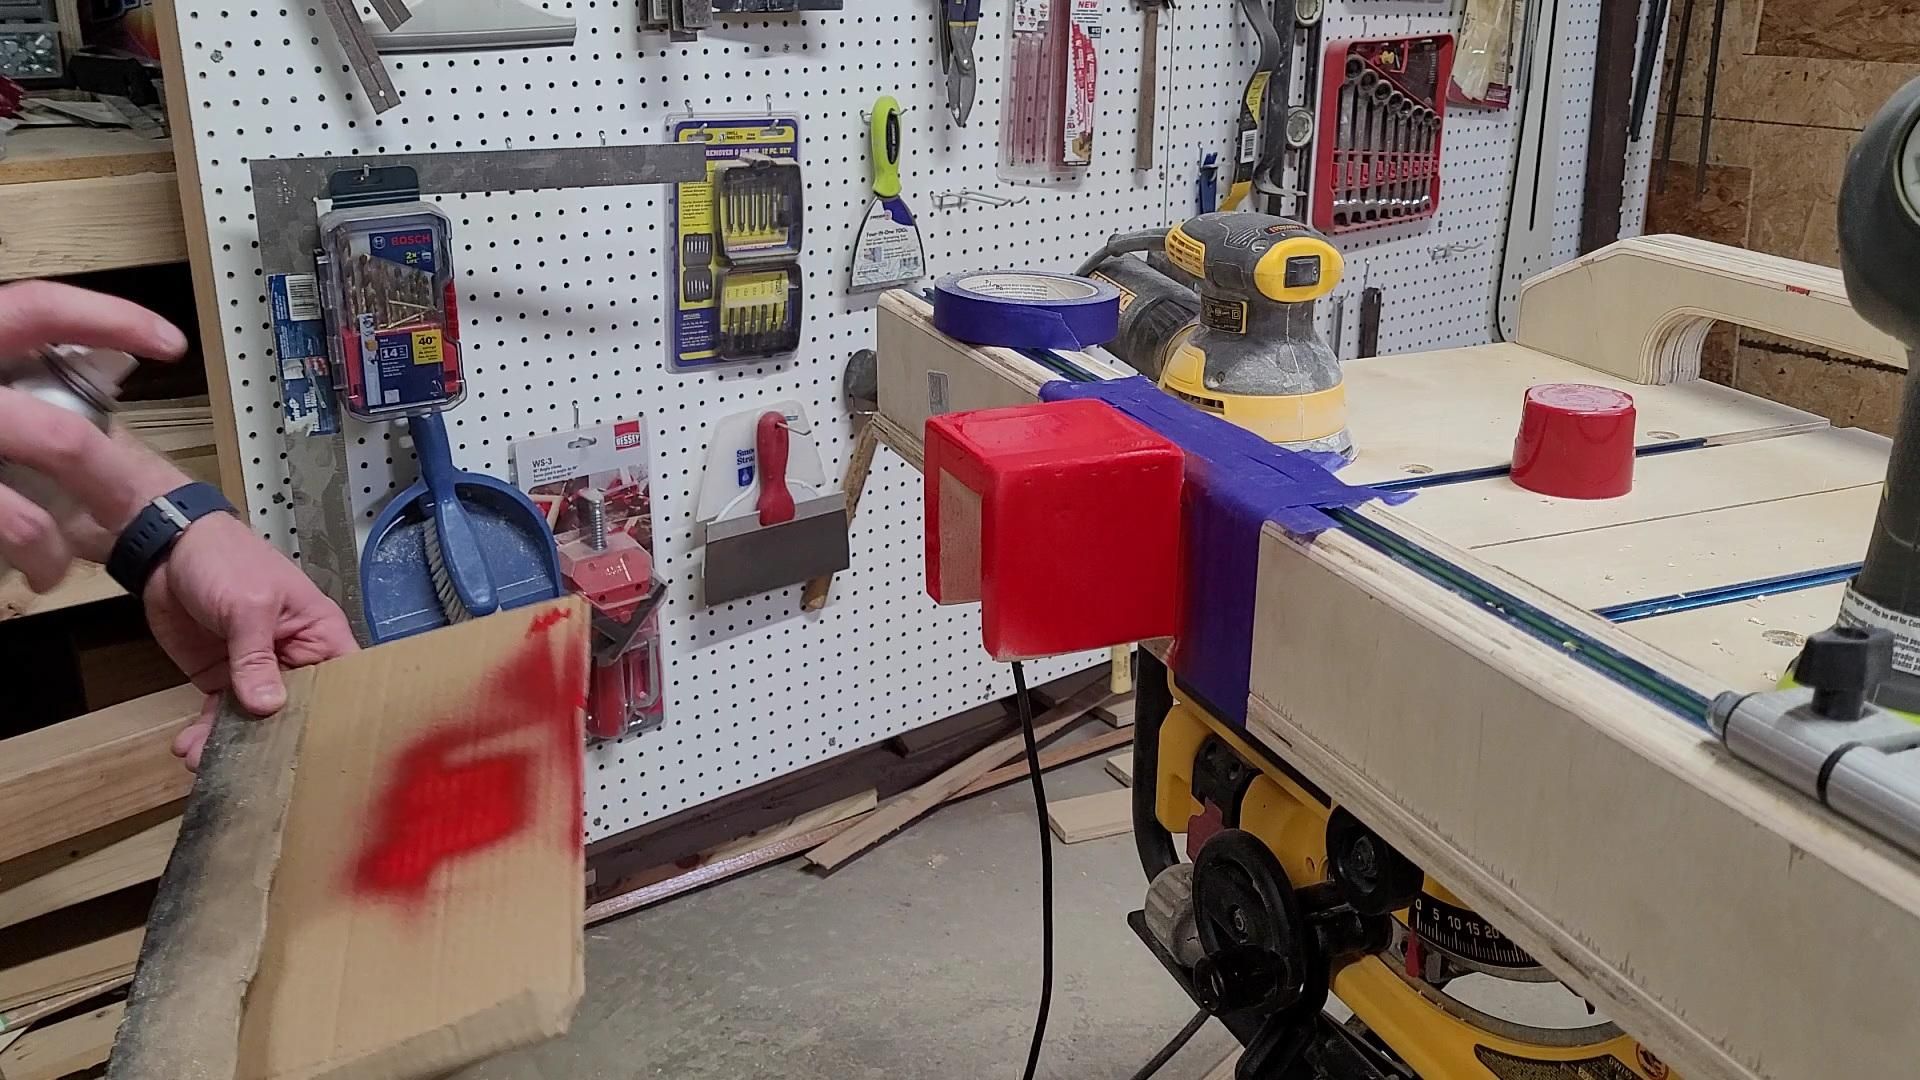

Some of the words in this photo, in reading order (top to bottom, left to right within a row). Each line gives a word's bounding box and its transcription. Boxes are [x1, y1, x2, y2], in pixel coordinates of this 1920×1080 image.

[1077, 1, 1099, 9] NEW
[391, 234, 431, 246] BOSCH
[382, 348, 399, 359] 14
[532, 457, 553, 468] WS-3
[1416, 899, 1422, 910] 0
[1433, 908, 1440, 921] 5
[1447, 916, 1461, 930] 10
[1466, 921, 1480, 936] 15
[1484, 925, 1500, 939] 20
